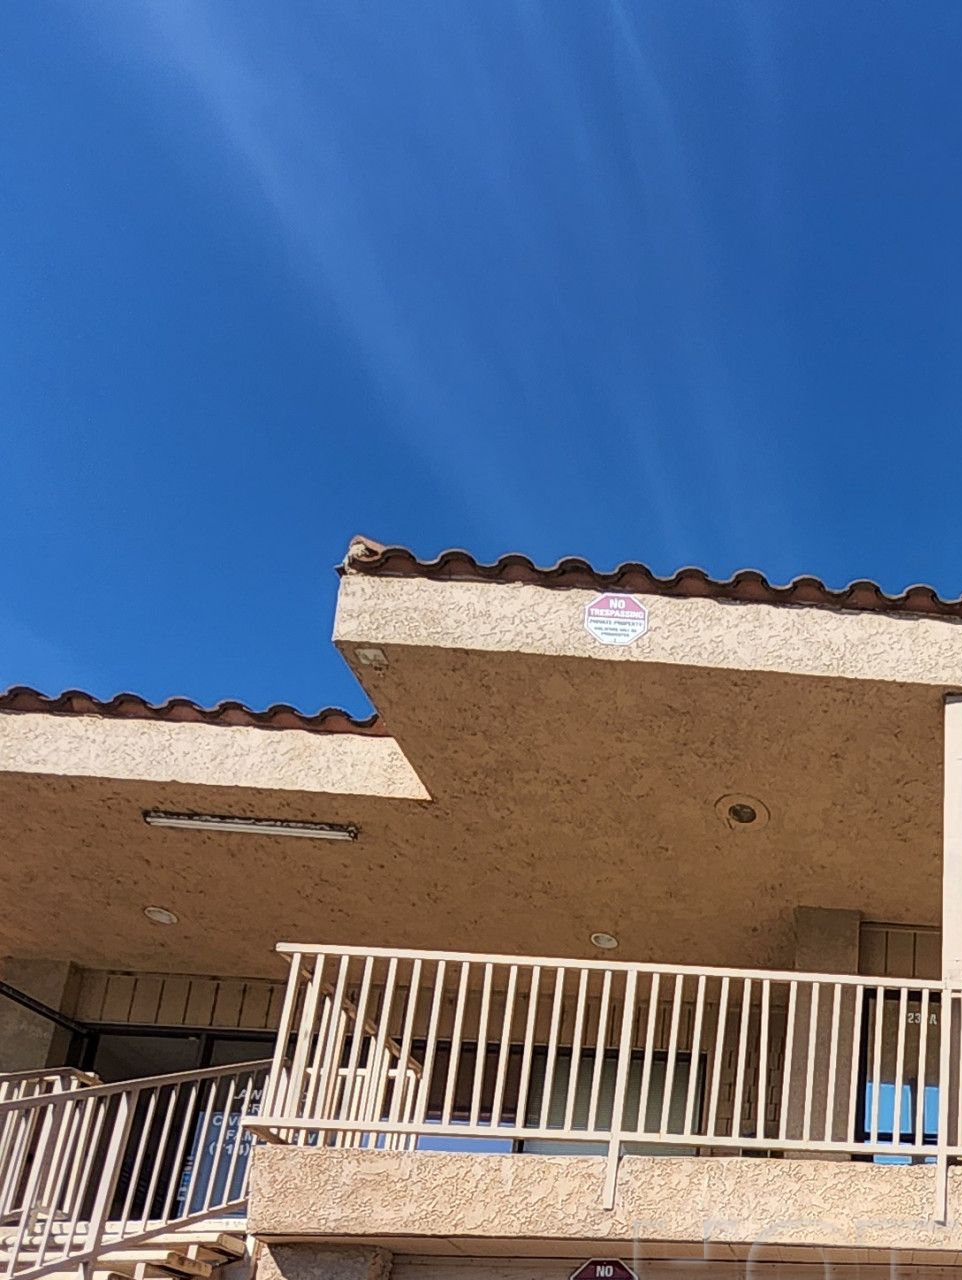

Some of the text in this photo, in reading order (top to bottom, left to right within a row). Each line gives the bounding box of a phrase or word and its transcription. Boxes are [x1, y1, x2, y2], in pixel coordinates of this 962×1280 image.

[609, 598, 626, 609] NO
[590, 608, 644, 619] TRESPASSING
[596, 1265, 614, 1278] NO
